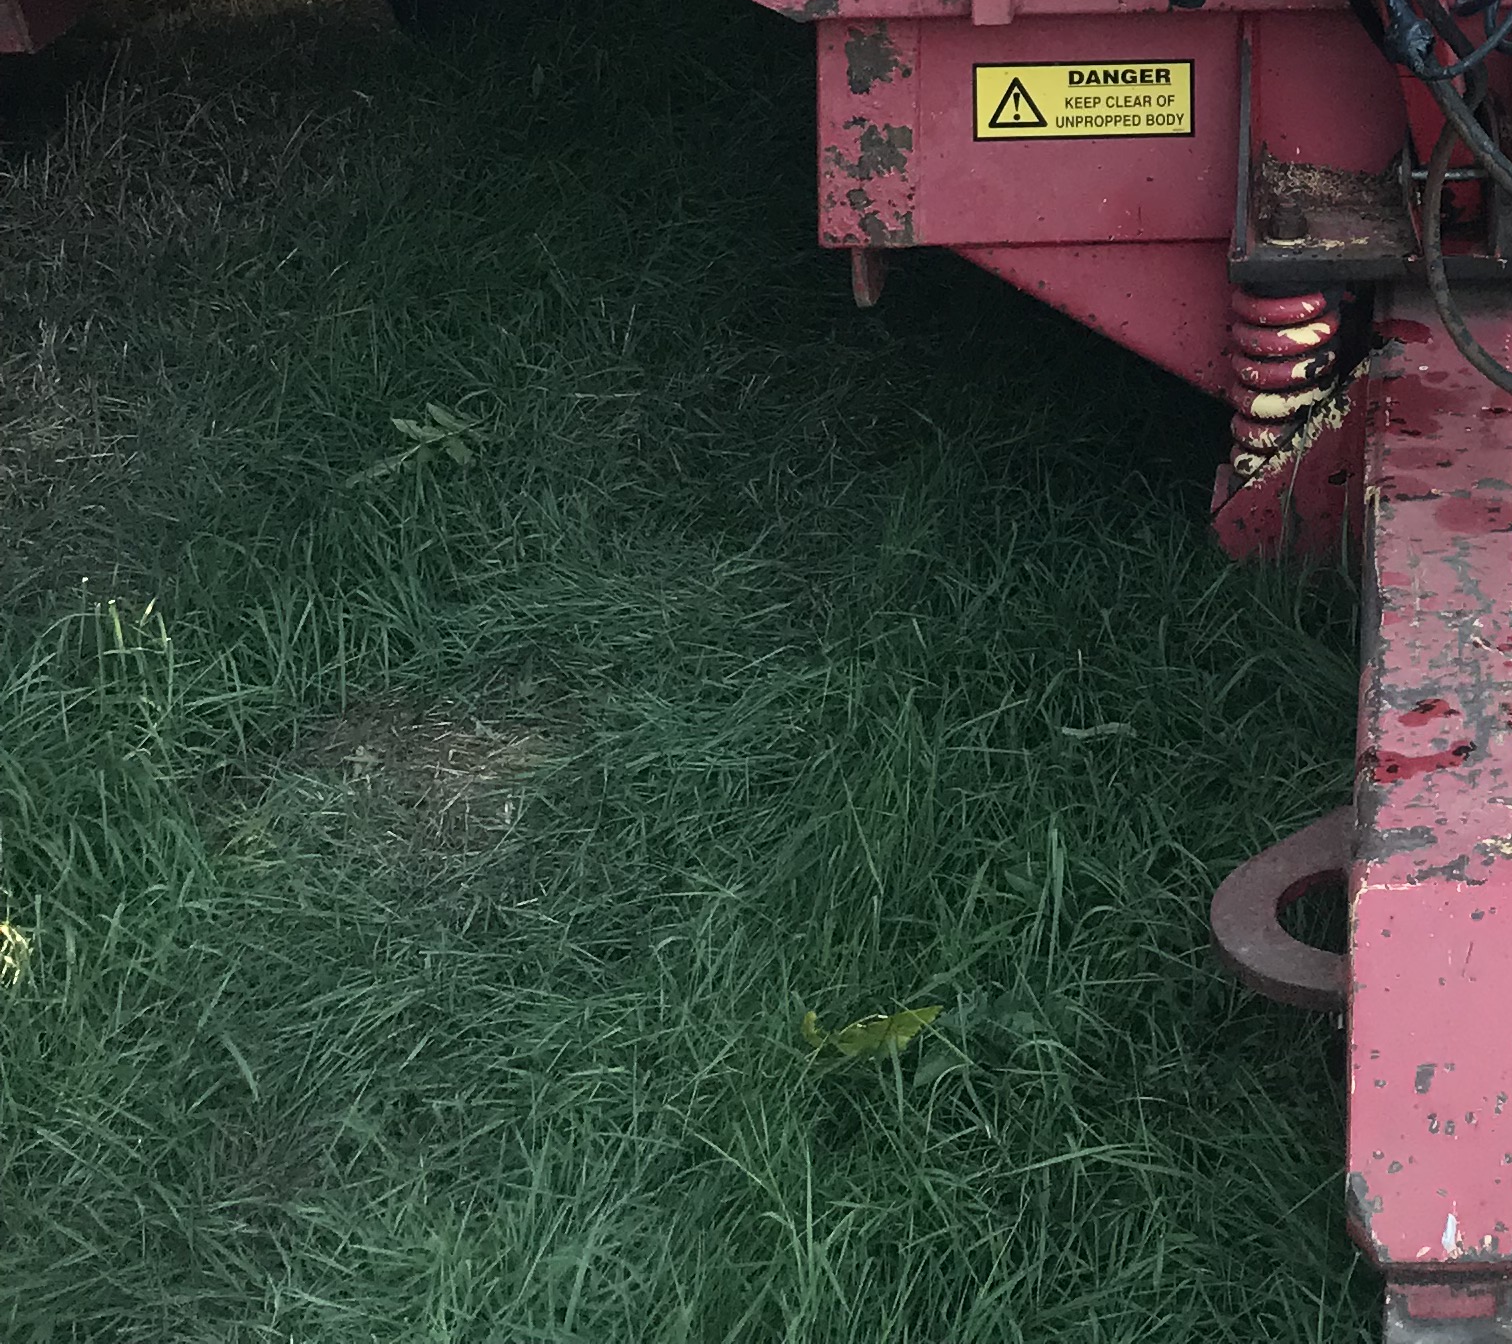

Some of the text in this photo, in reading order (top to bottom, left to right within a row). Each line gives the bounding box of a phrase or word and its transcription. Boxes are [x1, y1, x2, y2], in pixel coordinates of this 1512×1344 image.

[1068, 68, 1172, 85] DANGER
[1065, 94, 1176, 109] KEEP CLEAR OF
[1055, 113, 1185, 128] UNPROPPED BODY
